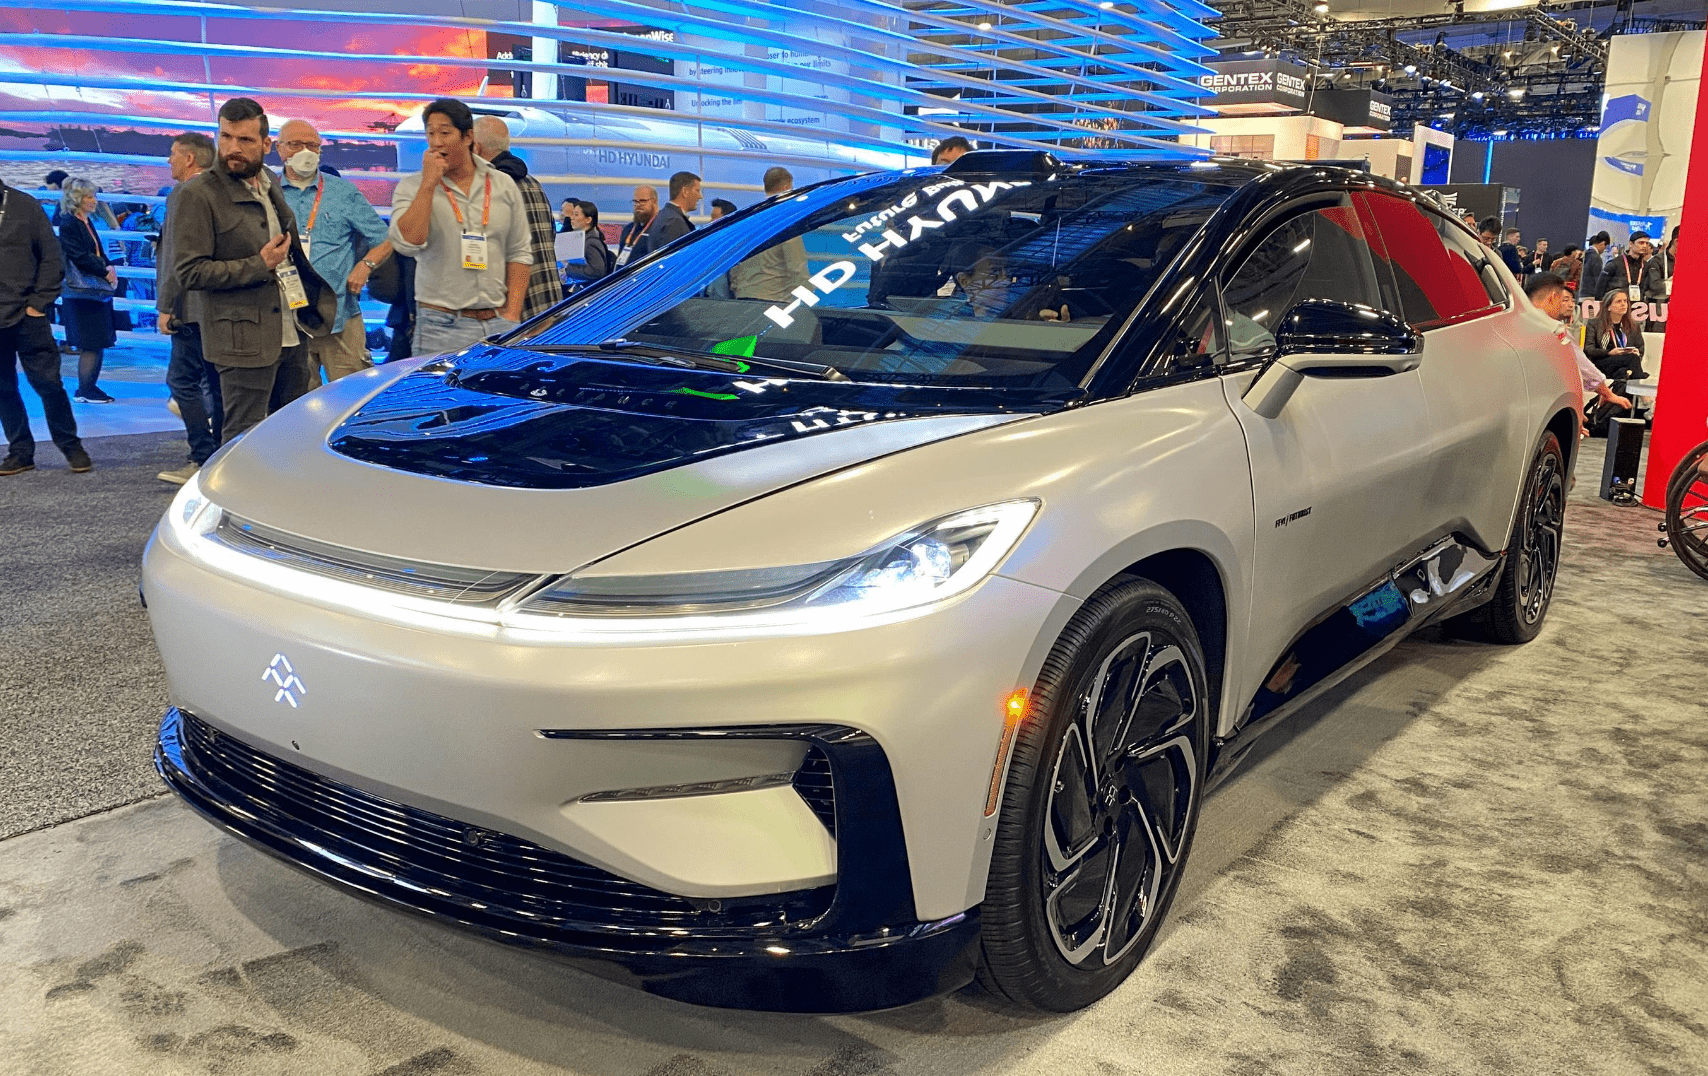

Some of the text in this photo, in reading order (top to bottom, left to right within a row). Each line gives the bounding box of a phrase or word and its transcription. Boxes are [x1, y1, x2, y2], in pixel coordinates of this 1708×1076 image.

[700, 67, 723, 75] teering
[1200, 71, 1273, 87] GENTEX
[1207, 83, 1273, 93] ORPORATION
[1276, 72, 1306, 91] GENTEX
[1369, 100, 1391, 116] GENTEX
[598, 149, 671, 169] HD HYUNDAI
